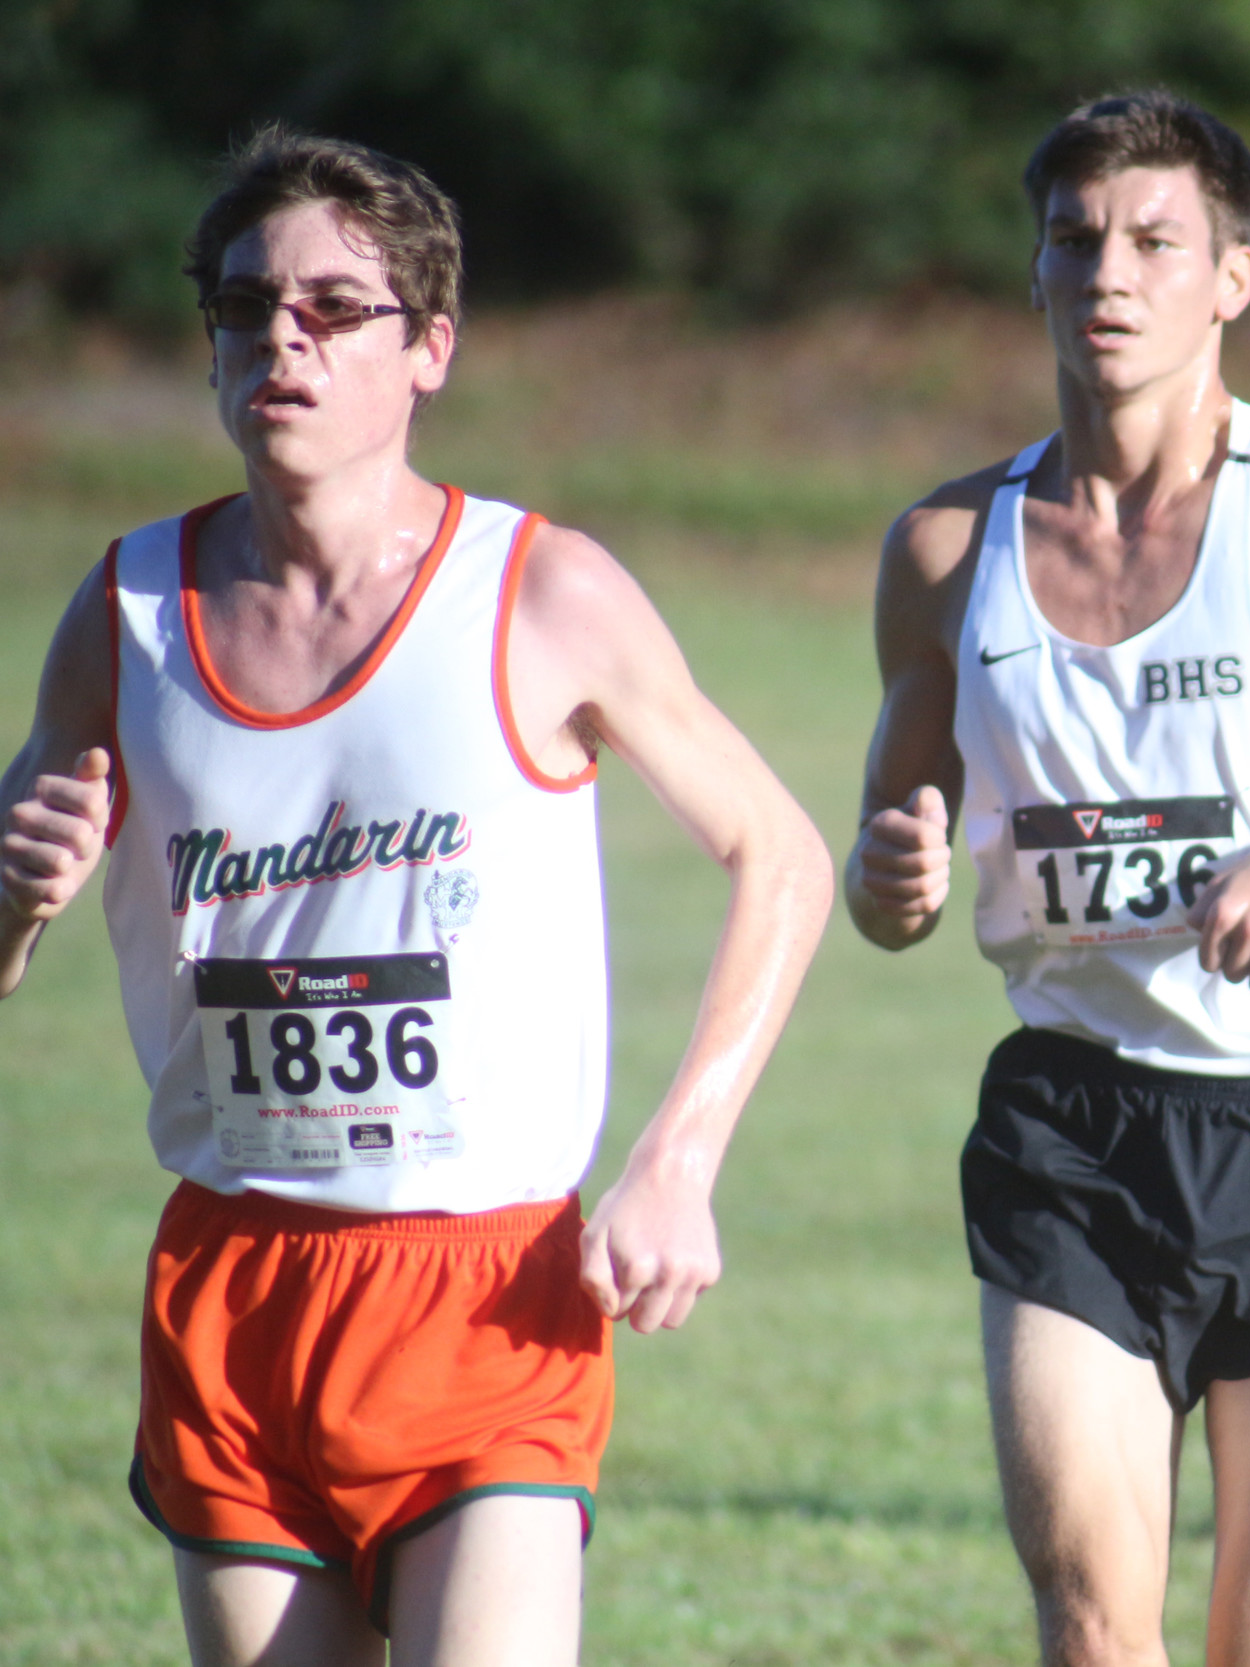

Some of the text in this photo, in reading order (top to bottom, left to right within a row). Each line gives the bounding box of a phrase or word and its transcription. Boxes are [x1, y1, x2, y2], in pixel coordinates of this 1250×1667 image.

[1143, 655, 1244, 704] BHS
[167, 801, 471, 916] Mandarin
[1037, 843, 1220, 924] 1736
[298, 973, 369, 991] RoadID
[225, 1006, 439, 1095] 1836
[258, 1104, 400, 1118] www.RoadID.com
